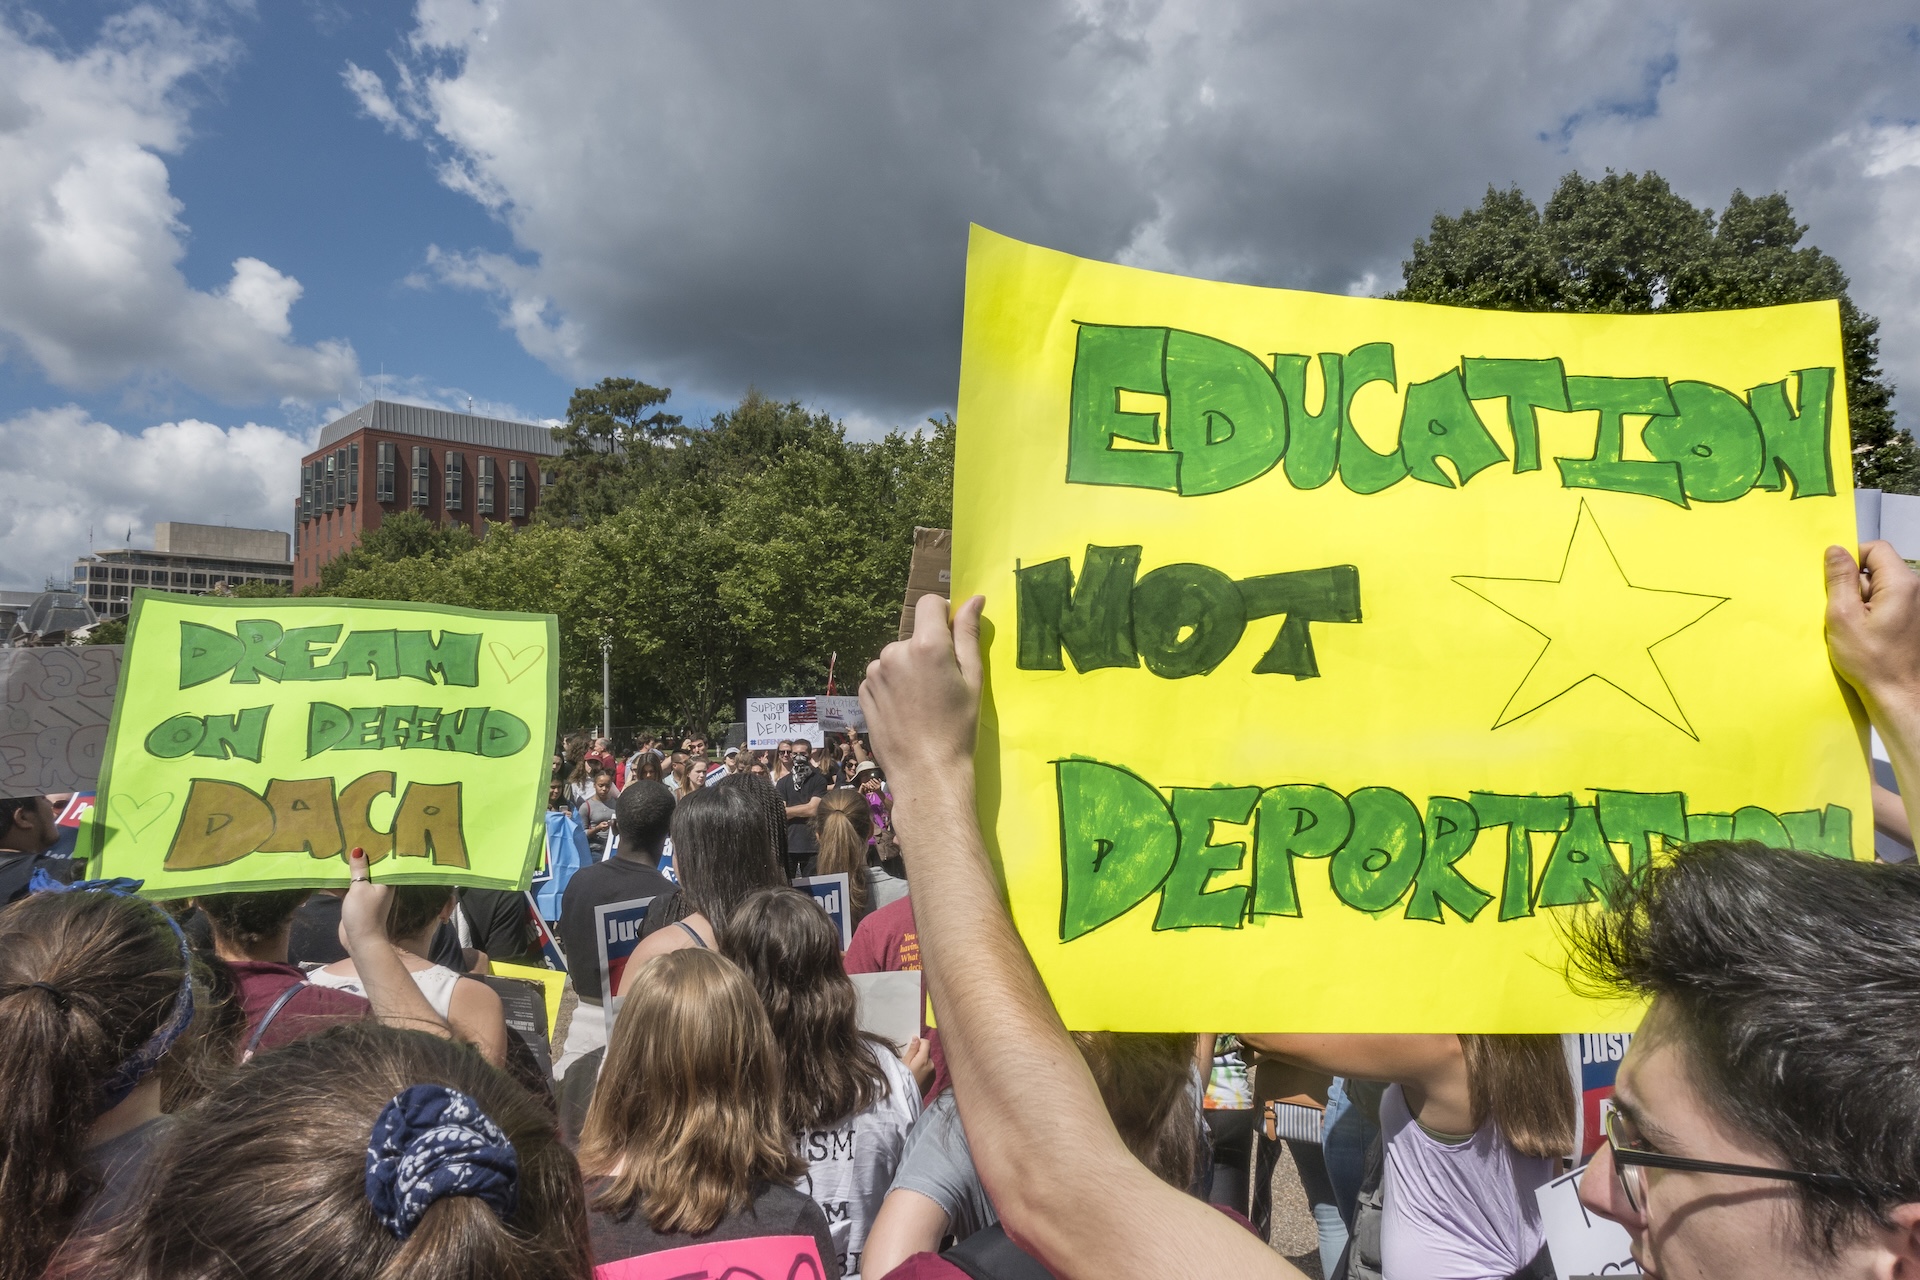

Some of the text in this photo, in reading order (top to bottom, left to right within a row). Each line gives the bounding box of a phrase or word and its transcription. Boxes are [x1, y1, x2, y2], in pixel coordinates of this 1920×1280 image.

[1065, 320, 1837, 510] EDUCATION
[1013, 544, 1363, 681] NOT
[179, 619, 483, 690] DREAM
[144, 702, 531, 763] ON DEFEND
[756, 722, 806, 736] DEPORT
[763, 711, 782, 721] NOT
[163, 770, 471, 871] DACA
[1047, 754, 1854, 944] DEPORTAT
[900, 942, 918, 953] havin
[901, 953, 918, 962] What
